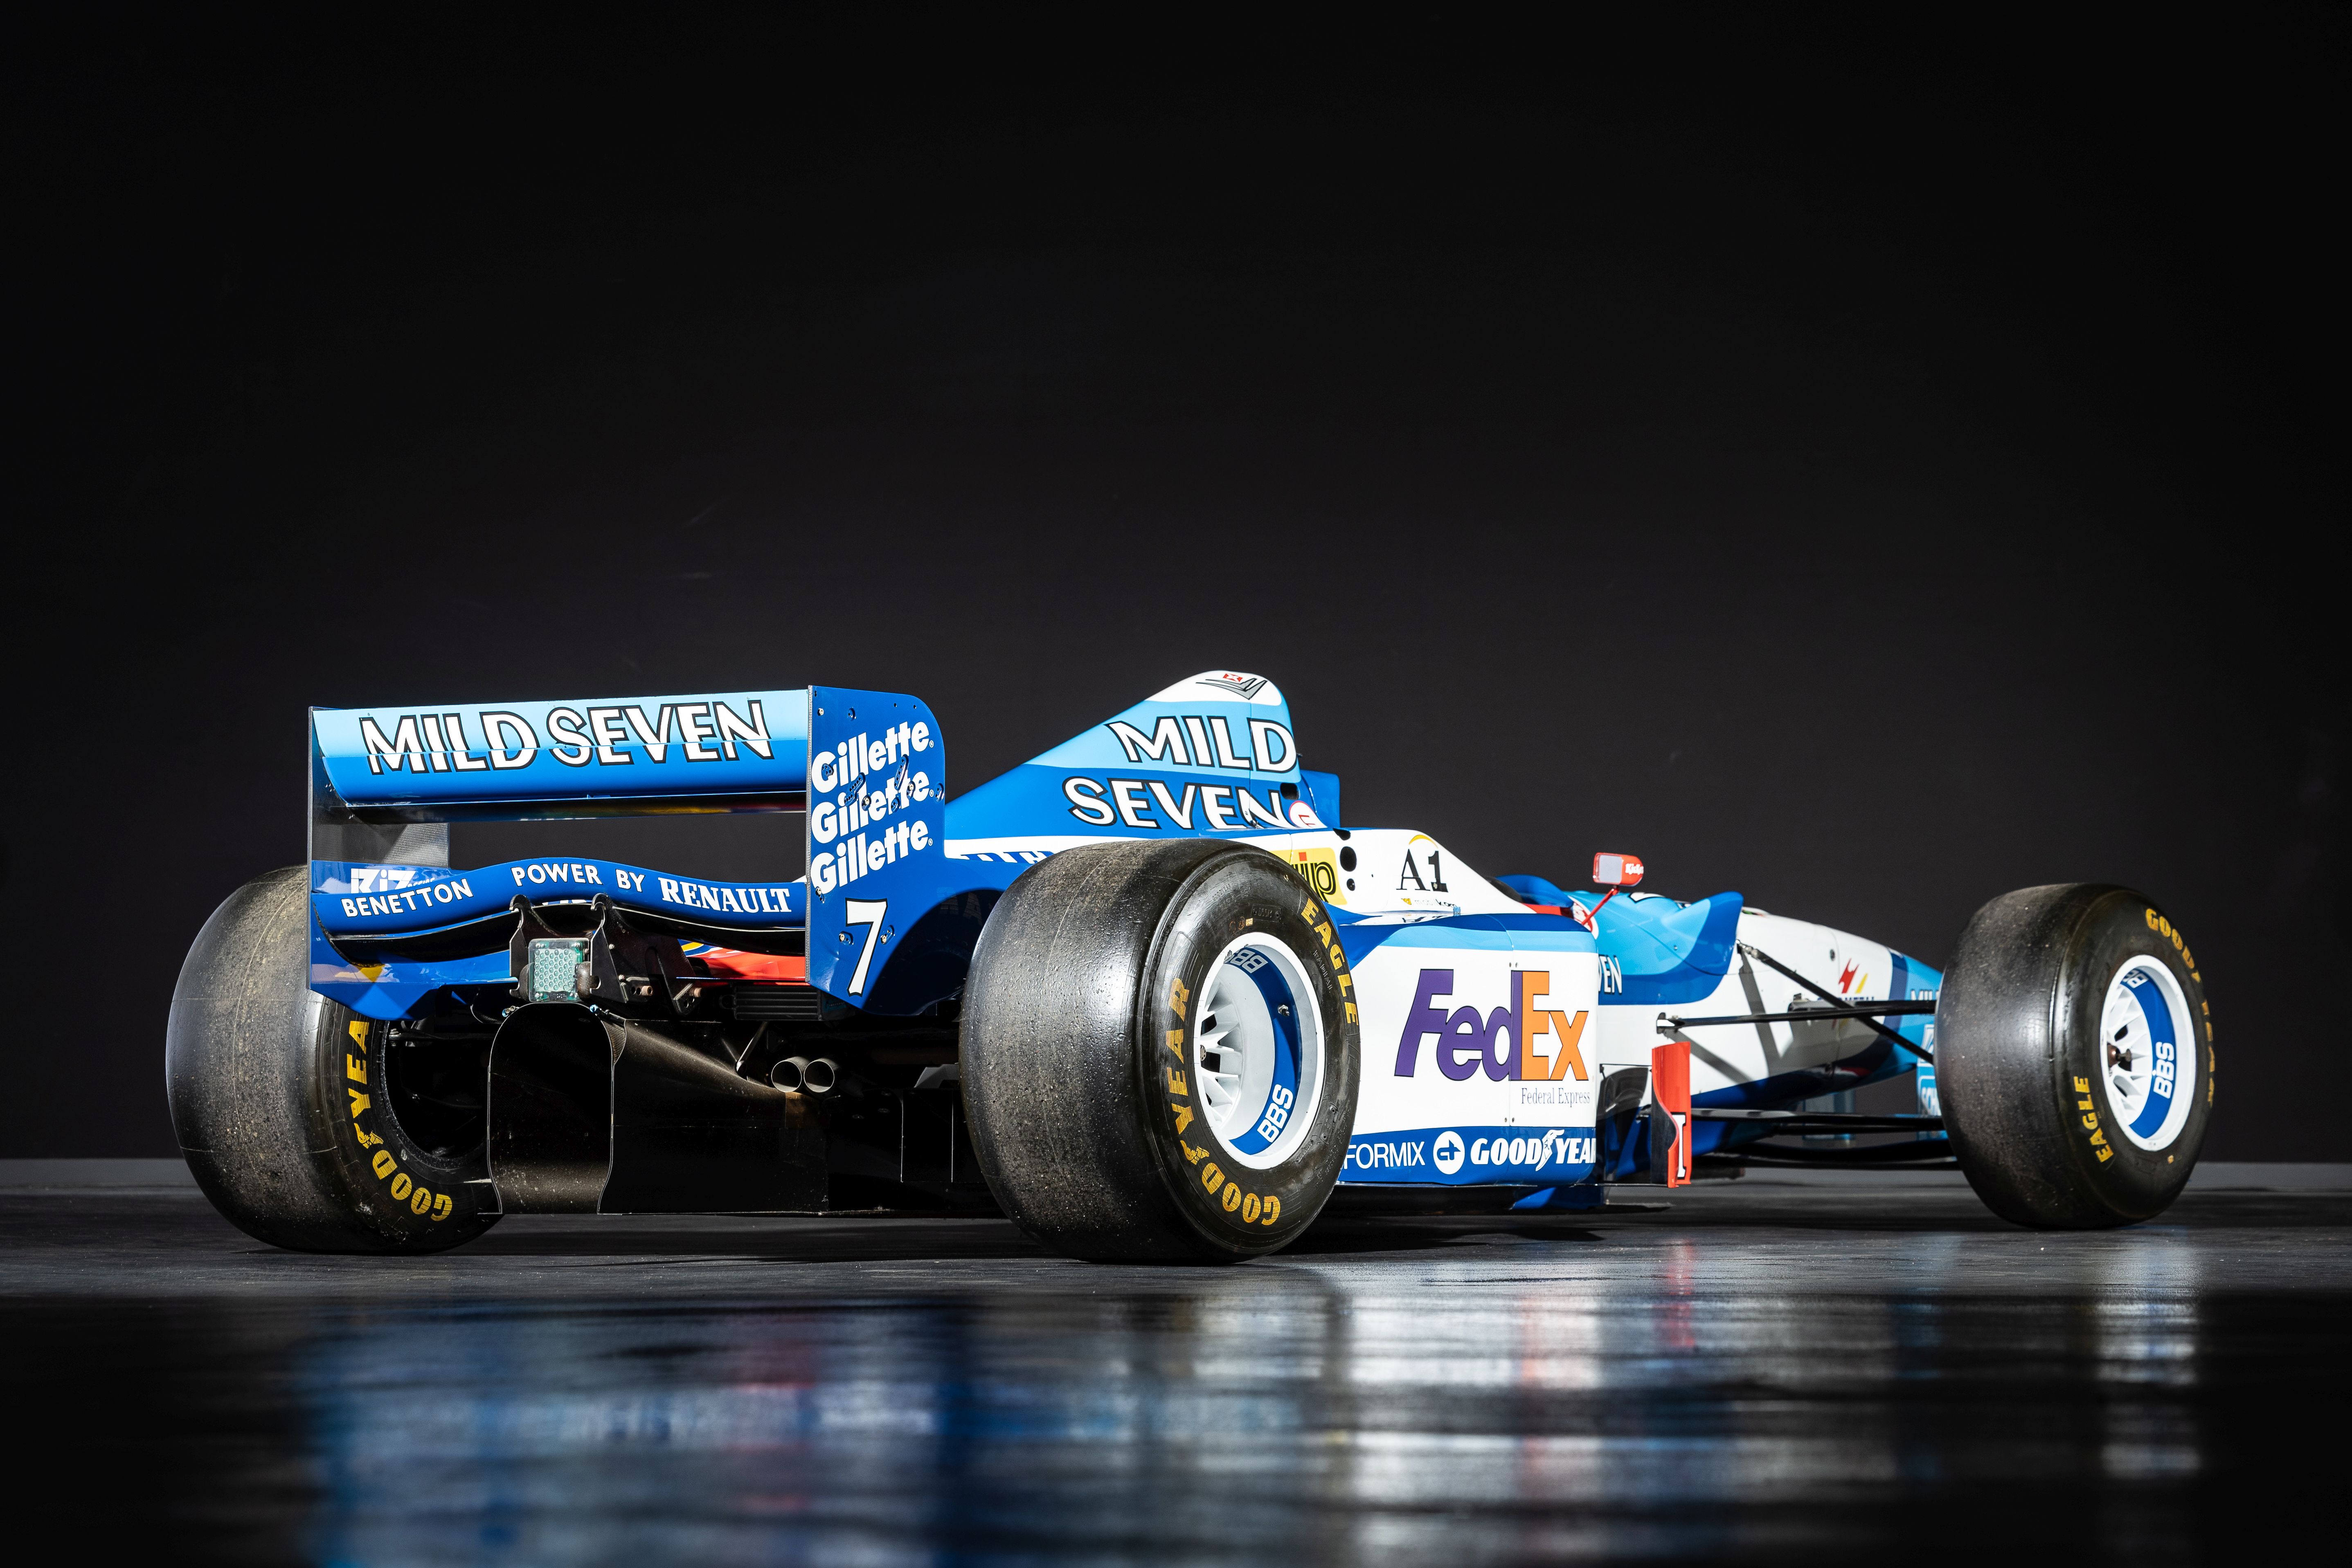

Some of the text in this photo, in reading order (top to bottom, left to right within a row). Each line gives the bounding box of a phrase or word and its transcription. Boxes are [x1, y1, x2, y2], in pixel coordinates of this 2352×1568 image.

[360, 700, 775, 775] MILD SEVEN
[1103, 715, 1297, 774] MILD
[1062, 776, 1293, 830] SEVEN
[341, 879, 474, 918] BENETTON
[510, 863, 792, 913] POWER BY RENAULT
[1396, 848, 1449, 893] A1
[845, 899, 888, 997] 7
[1227, 948, 1268, 974] BB
[1301, 898, 1359, 1026] EAGLE
[1394, 968, 1589, 1082] FedEx
[1521, 1088, 1590, 1107] Federal Express
[2153, 1042, 2174, 1099] BBS
[1166, 978, 1281, 1226] GOODYEAR
[1257, 1084, 1293, 1143] BBS
[2074, 1076, 2114, 1163] EAGLE
[1344, 1141, 1425, 1170] FORMIX
